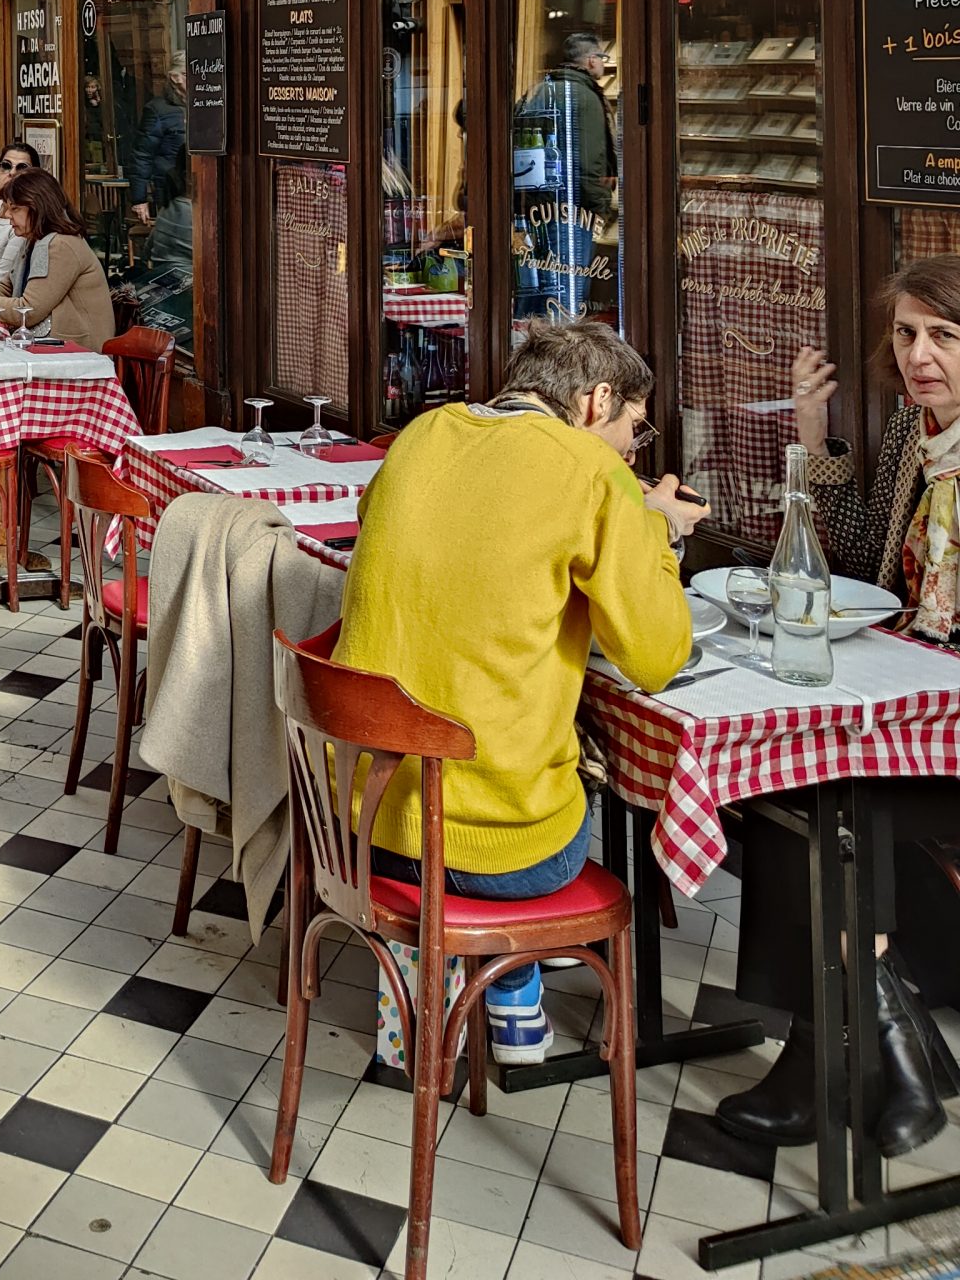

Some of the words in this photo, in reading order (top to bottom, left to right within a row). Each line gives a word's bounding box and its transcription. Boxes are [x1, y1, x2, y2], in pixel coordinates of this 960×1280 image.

[84, 8, 94, 28] 11
[290, 9, 313, 24] PLATS
[187, 22, 200, 37] PLAT
[200, 23, 207, 35] du
[208, 18, 223, 35] JOUR
[882, 36, 897, 55] +
[904, 36, 917, 52] 1
[20, 62, 60, 88] GARCIA
[17, 94, 62, 114] PHILATELIE
[268, 87, 304, 101] DESSERTS
[896, 98, 922, 112] Verre
[925, 97, 937, 111] de
[939, 98, 954, 111] vin
[925, 153, 935, 168] A
[289, 176, 328, 199] SALLES
[904, 170, 921, 184] Plat
[924, 173, 935, 185] au
[529, 201, 605, 240] CUISINE
[681, 226, 711, 261] VINS
[714, 221, 727, 242] de
[731, 217, 820, 276] PROPRIÉTÉ
[514, 245, 614, 280] Traditionnelle
[769, 280, 826, 310] bouteille
